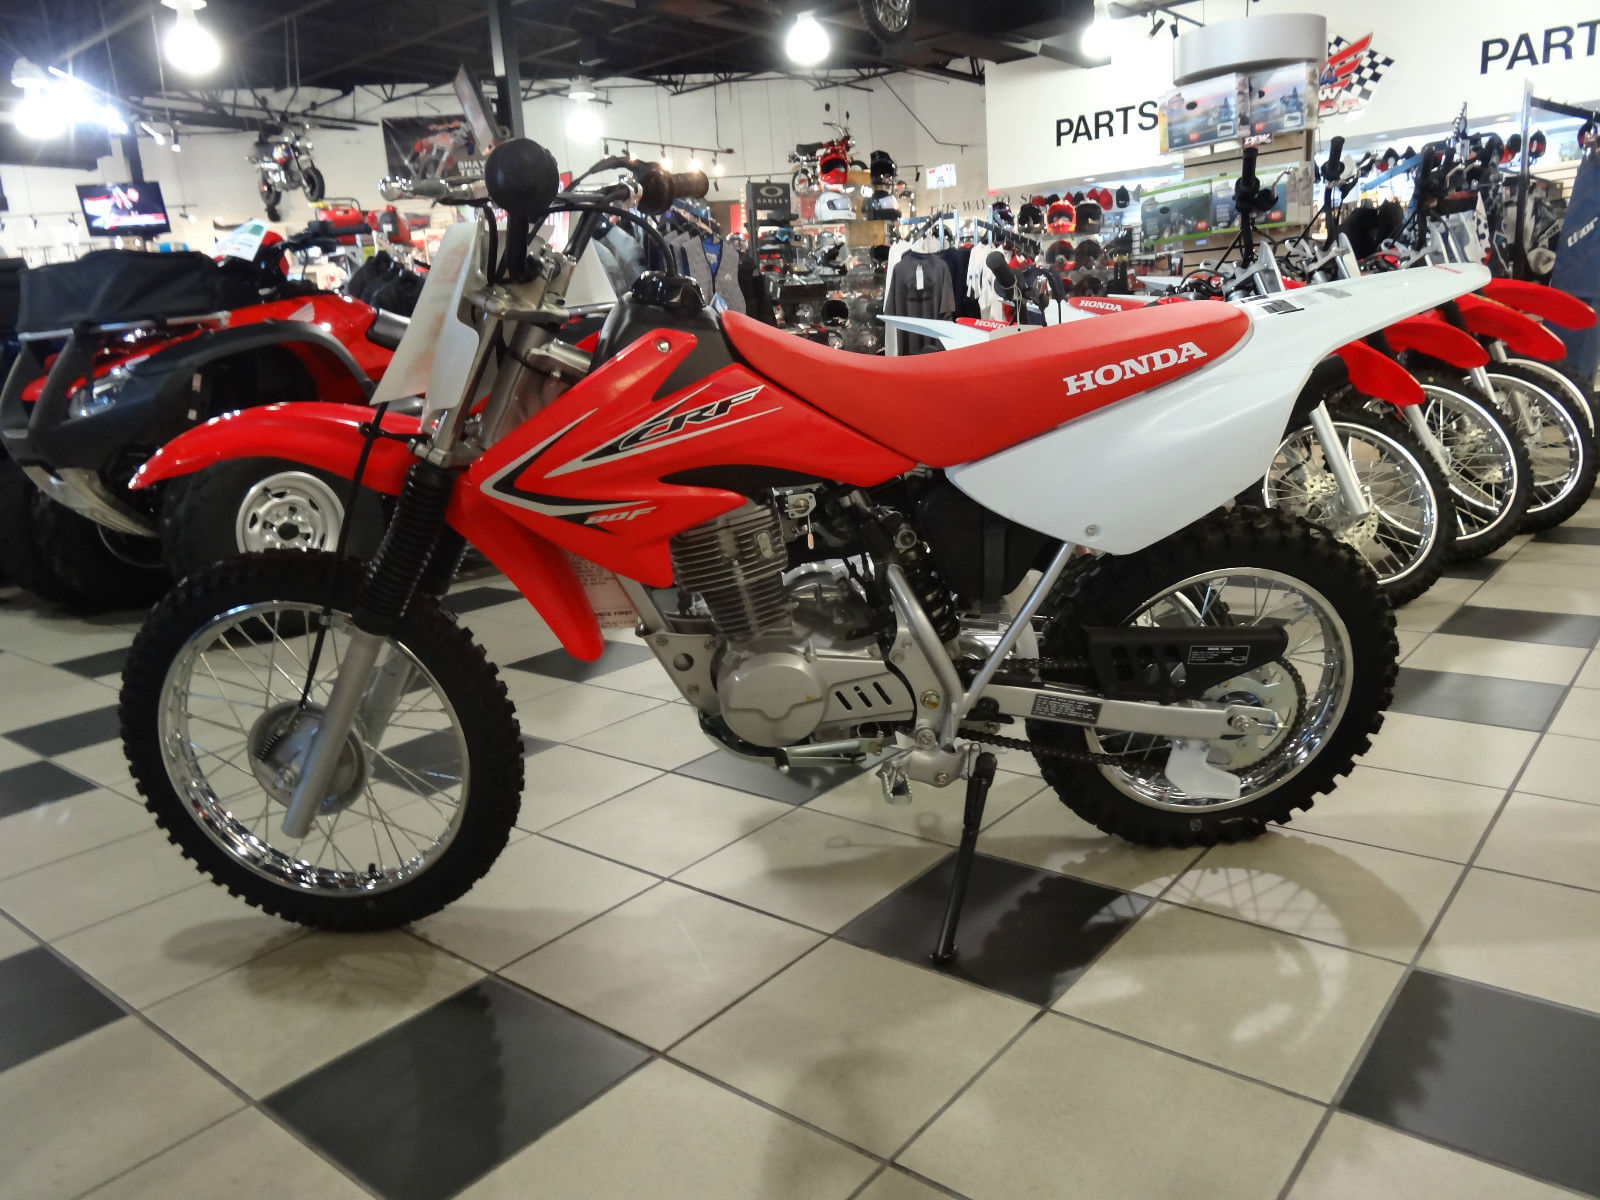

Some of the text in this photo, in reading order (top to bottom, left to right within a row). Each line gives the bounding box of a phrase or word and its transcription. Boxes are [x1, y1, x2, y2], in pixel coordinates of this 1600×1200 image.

[1056, 100, 1158, 147] PARTS
[1079, 299, 1122, 312] HONDA
[1063, 341, 1208, 396] HONDA
[619, 383, 766, 451] CRF
